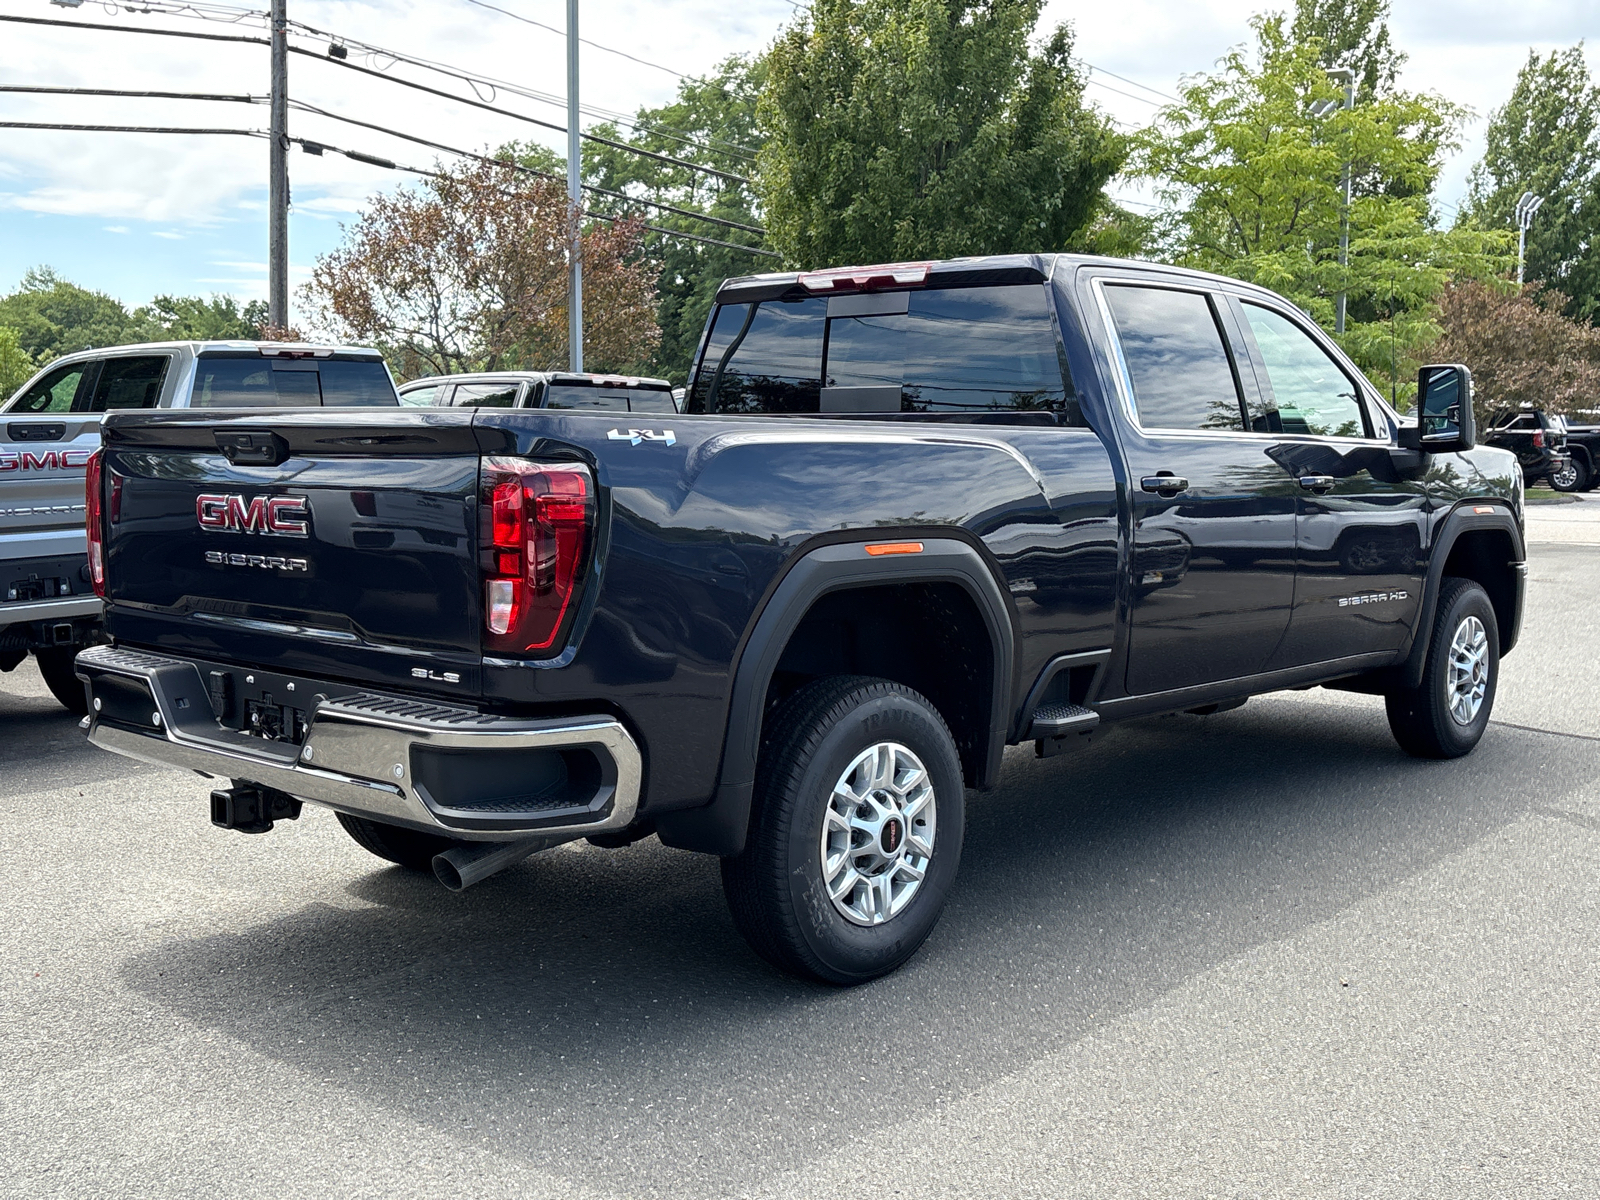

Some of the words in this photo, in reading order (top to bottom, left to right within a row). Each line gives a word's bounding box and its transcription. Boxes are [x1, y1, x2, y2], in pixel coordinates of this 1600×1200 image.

[0, 449, 91, 471] GMC
[196, 493, 309, 539] GMC
[204, 550, 308, 571] SIERRA
[1338, 593, 1388, 607] SIERRA
[1389, 591, 1408, 601] HD
